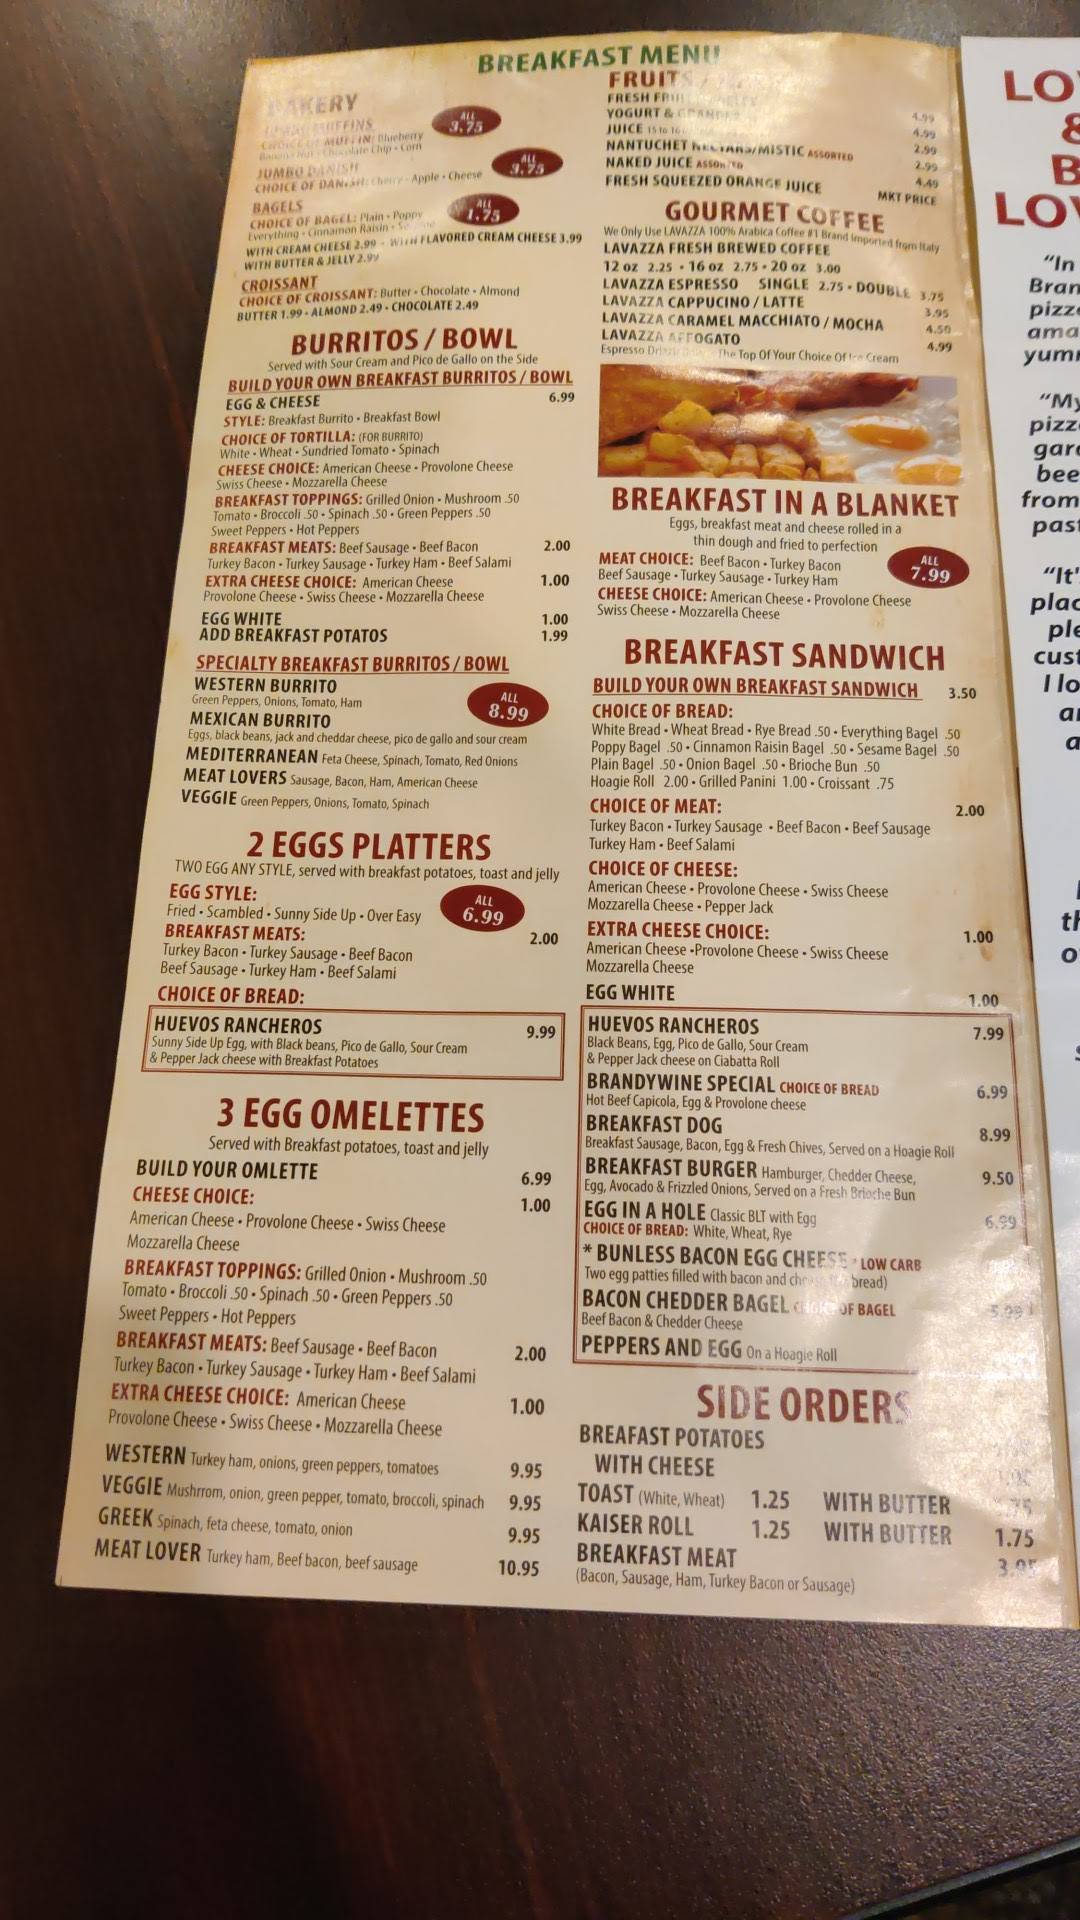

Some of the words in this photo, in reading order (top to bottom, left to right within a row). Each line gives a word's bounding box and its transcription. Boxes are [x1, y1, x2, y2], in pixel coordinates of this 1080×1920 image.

[478, 46, 632, 73] BREAKFAST
[1004, 69, 1080, 102] LO
[252, 200, 303, 215] BAGELS
[665, 200, 789, 222] GOURMET
[796, 205, 884, 233] COFFEE
[604, 242, 664, 254] LAVAZZA
[669, 242, 712, 254] FRESH
[717, 243, 776, 254] BREWED
[780, 243, 830, 255] COFFEE
[604, 260, 619, 272] 12
[622, 263, 638, 272] oz
[648, 262, 672, 272] 2.25
[688, 260, 705, 272] 16
[708, 262, 723, 272] oz
[733, 261, 758, 272] 2.75
[771, 261, 787, 272] 20
[791, 263, 806, 272] oz
[816, 263, 840, 274] 3.00
[241, 275, 318, 294] CROISSANT
[237, 310, 277, 321] BUTTER
[281, 308, 302, 319] 1.99
[311, 304, 357, 317] ALMOND
[359, 303, 382, 313] 2.49
[391, 300, 452, 312] CHOCOLATE
[455, 300, 479, 310] 2.49
[291, 329, 418, 355] BURRITOS
[442, 327, 517, 349] BOWL
[268, 359, 302, 372] Served
[304, 358, 327, 370] with
[330, 358, 353, 369] Sour
[355, 357, 387, 367] Cream
[390, 356, 409, 366] and
[412, 355, 433, 365] Pico
[435, 355, 448, 365] de
[451, 354, 477, 364] Gallo
[480, 356, 493, 364] on
[496, 353, 513, 364] the
[516, 353, 538, 364] Side
[225, 398, 252, 410] EGG
[255, 397, 265, 409] &
[269, 394, 320, 408] CHEESE
[549, 392, 574, 402] 6.99
[612, 487, 766, 513] BREAKFAST
[775, 489, 802, 514] IN
[811, 491, 828, 515] A
[836, 492, 958, 517] BLANKET
[1021, 489, 1079, 509] from
[670, 516, 697, 531] Eggs,
[701, 517, 751, 530] breakfast
[754, 521, 781, 532] meat
[784, 521, 804, 533] and
[808, 521, 845, 534] cheese
[848, 522, 878, 535] rolled
[882, 523, 892, 534] in
[895, 525, 901, 534] a
[920, 554, 939, 566] ALL
[910, 565, 951, 584] 7.99
[202, 611, 229, 625] EGG
[234, 611, 282, 626] WHITE
[542, 613, 568, 625] 1.00
[199, 627, 230, 641] ADD
[234, 627, 320, 642] BREAKFAST
[323, 628, 387, 643] POTATOS
[541, 630, 568, 641] 1.99
[625, 638, 784, 666] BREAKFAST
[792, 642, 944, 671] SANDWICH
[194, 676, 265, 692] WESTERN
[270, 678, 337, 693] BURRITO
[948, 687, 976, 699] 3.50
[500, 691, 519, 703] ALL
[488, 703, 529, 722] 8.99
[186, 746, 318, 763] MEDITERRANEAN
[181, 788, 237, 805] VEGGIE
[246, 831, 263, 857] 2
[272, 831, 343, 858] EGGS
[352, 832, 490, 861] PLATTERS
[169, 883, 200, 899] EGG
[204, 884, 257, 901] STYLE:
[474, 894, 494, 907] ALL
[167, 903, 196, 917] Fried
[206, 905, 263, 919] Scambled
[274, 906, 310, 923] Sunny
[313, 907, 337, 920] Side
[341, 908, 356, 924] Up
[367, 908, 393, 922] Over
[396, 909, 421, 925] Easy
[462, 906, 504, 926] 6.99
[530, 932, 558, 945] 2.00
[154, 1015, 219, 1032] HUEVOS
[224, 1016, 322, 1034] RANCHEROS
[526, 1025, 555, 1039] 9.99
[589, 1016, 654, 1032] HUEVOS
[659, 1017, 759, 1035] RANCHEROS
[973, 1027, 1004, 1040] 7.99
[587, 1072, 702, 1091] BRANDYWINE
[707, 1075, 775, 1093] SPECIAL
[977, 1085, 1008, 1099] 6.99
[217, 1097, 233, 1127] 3
[244, 1097, 302, 1128] EGG
[311, 1099, 484, 1133] OMELETTES
[587, 1114, 682, 1133] BREAKFAST
[687, 1117, 722, 1134] DOG
[979, 1127, 1010, 1142] 8.99
[136, 1159, 187, 1176] BUILD
[192, 1160, 237, 1178] YOUR
[241, 1161, 318, 1180] OMLETTE
[521, 1171, 551, 1186] 6.99
[585, 1157, 682, 1176] BREAKFAST
[687, 1159, 757, 1178] BURGER
[982, 1171, 1014, 1185] 9.50
[521, 1198, 550, 1212] 1.00
[697, 1384, 770, 1420] SIDE
[780, 1386, 908, 1424] ORDERS
[579, 1424, 670, 1446] BREAFAST
[675, 1427, 764, 1449] POTATOES
[106, 1443, 186, 1465] WESTERN
[191, 1451, 225, 1470] Turkey
[228, 1453, 256, 1470] ham,
[259, 1455, 298, 1471] onions,
[301, 1459, 333, 1474] green
[336, 1461, 383, 1476] peppers,
[386, 1461, 439, 1475] tomatoes
[510, 1462, 542, 1479] 9.95
[594, 1454, 642, 1474] WITH
[648, 1455, 714, 1477] CHEESE
[102, 1475, 163, 1496] VEGGIE
[509, 1494, 541, 1511] 9.95
[577, 1482, 634, 1503] TOAST
[638, 1489, 680, 1508] (White,
[683, 1491, 724, 1509] Wheat)
[751, 1490, 789, 1509] 1.25
[98, 1507, 153, 1527] GREEK
[508, 1527, 540, 1544] 9.95
[94, 1538, 141, 1559] MEAT
[146, 1541, 201, 1562] LOVER
[498, 1559, 539, 1576] 10.95
[577, 1543, 682, 1566] BREAKFAST
[687, 1547, 736, 1568] MEAT
[576, 1567, 618, 1585] (Bacon,
[621, 1569, 672, 1589] Sausage,
[675, 1571, 706, 1589] Ham,
[708, 1572, 746, 1592] Turkey
[749, 1574, 784, 1590] Bacon
[787, 1580, 799, 1590] or
[802, 1576, 854, 1596] Sausage)
